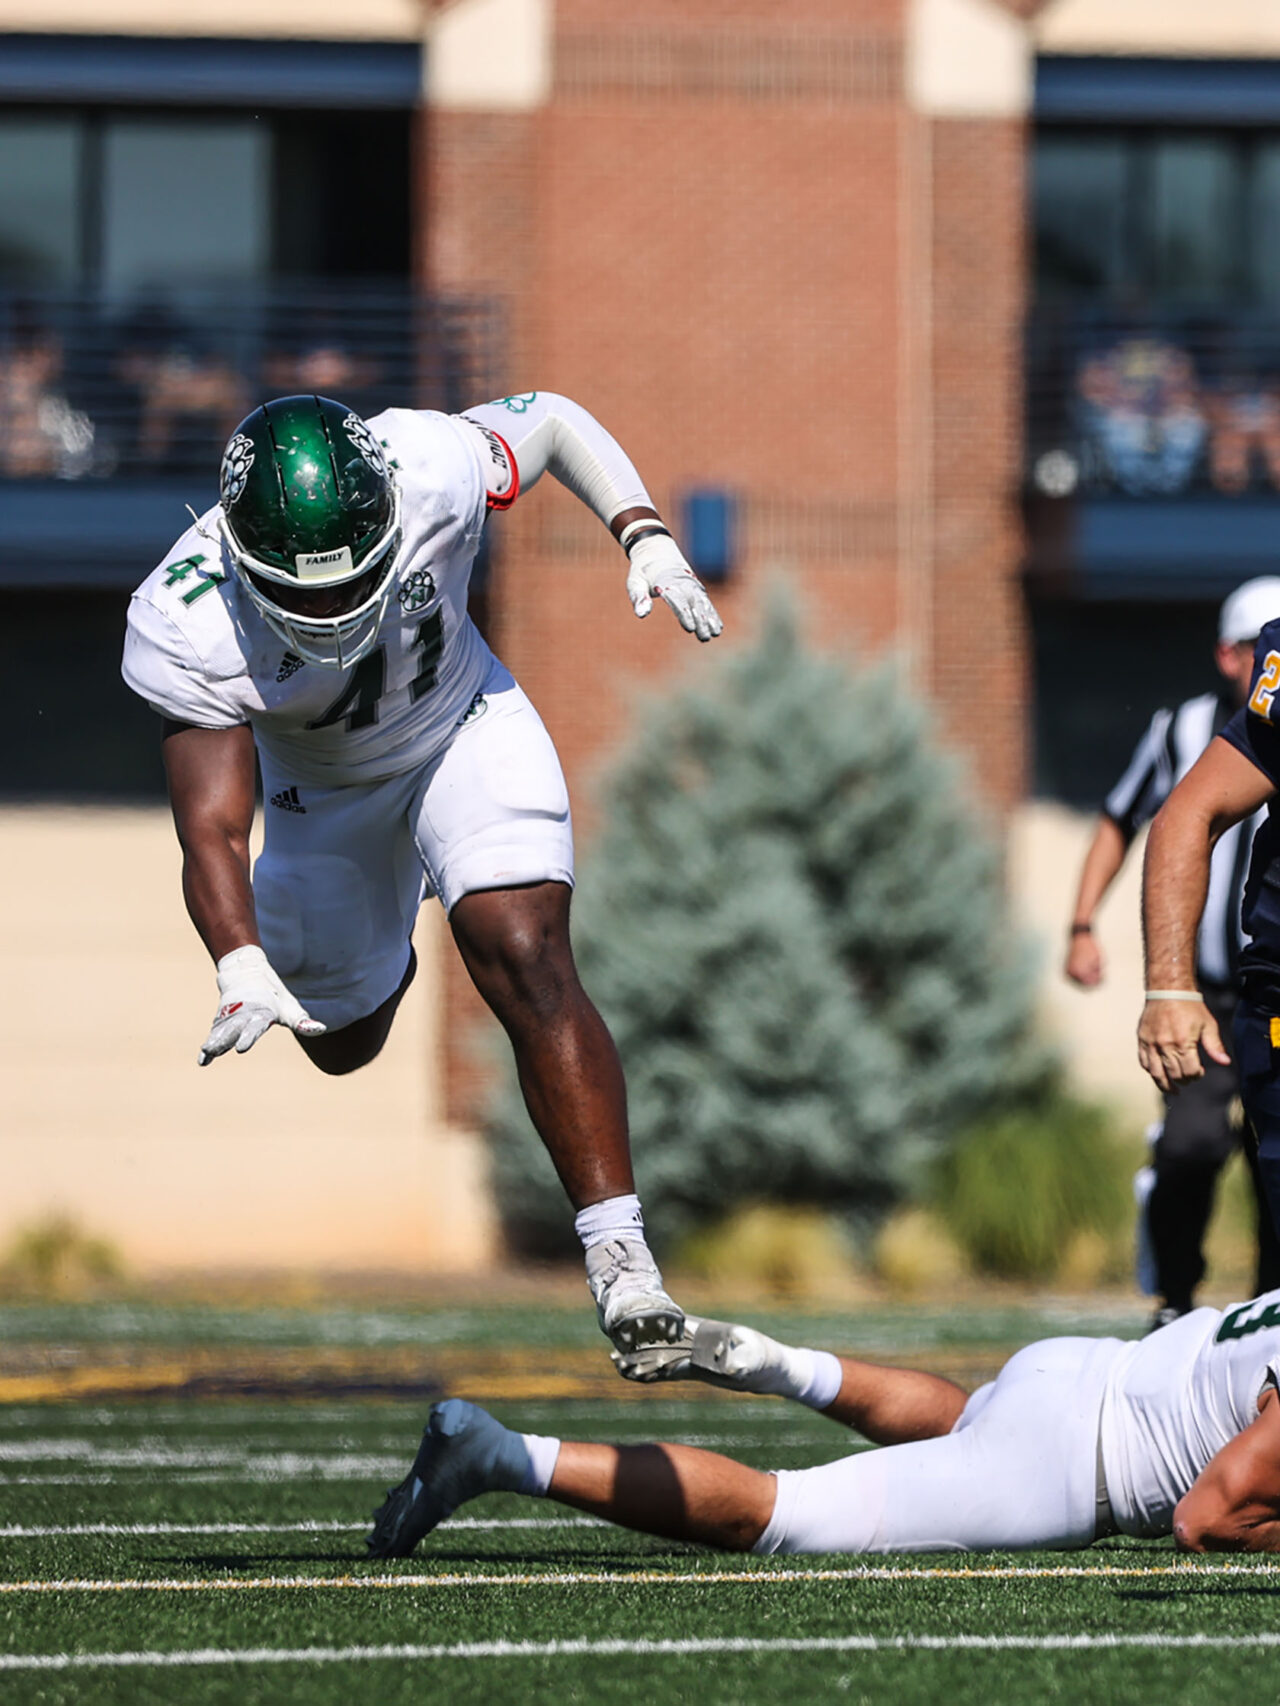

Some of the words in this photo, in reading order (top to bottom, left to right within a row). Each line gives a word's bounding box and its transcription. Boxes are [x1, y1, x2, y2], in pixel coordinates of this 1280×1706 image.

[305, 551, 344, 566] FAMILY
[275, 659, 305, 683] adida
[305, 600, 445, 733] 41
